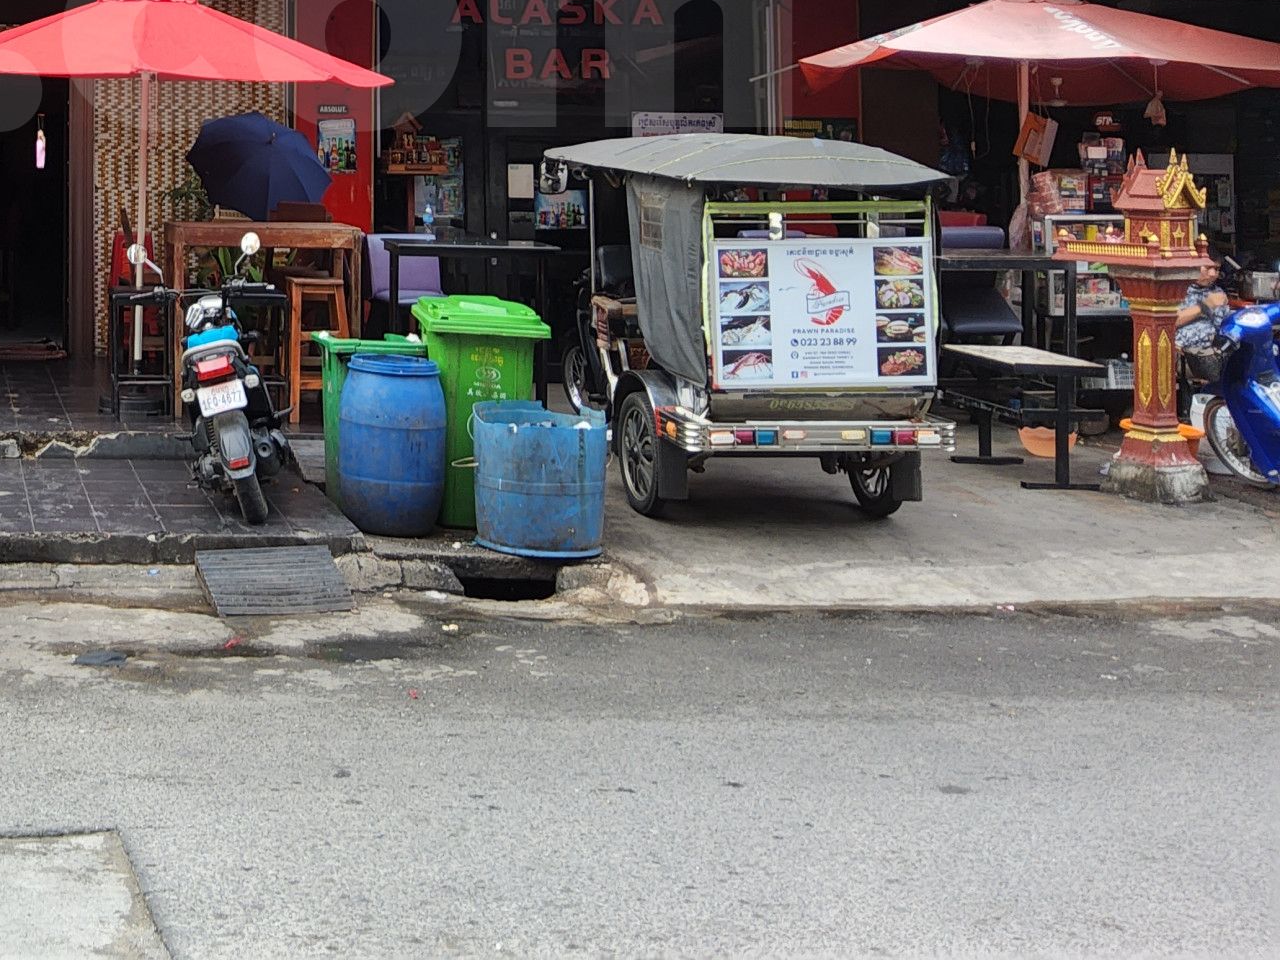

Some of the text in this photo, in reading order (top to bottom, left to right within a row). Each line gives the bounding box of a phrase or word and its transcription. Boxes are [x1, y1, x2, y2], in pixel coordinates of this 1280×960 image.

[505, 48, 612, 80] BAR
[800, 337, 858, 347] 023 23 88 99
